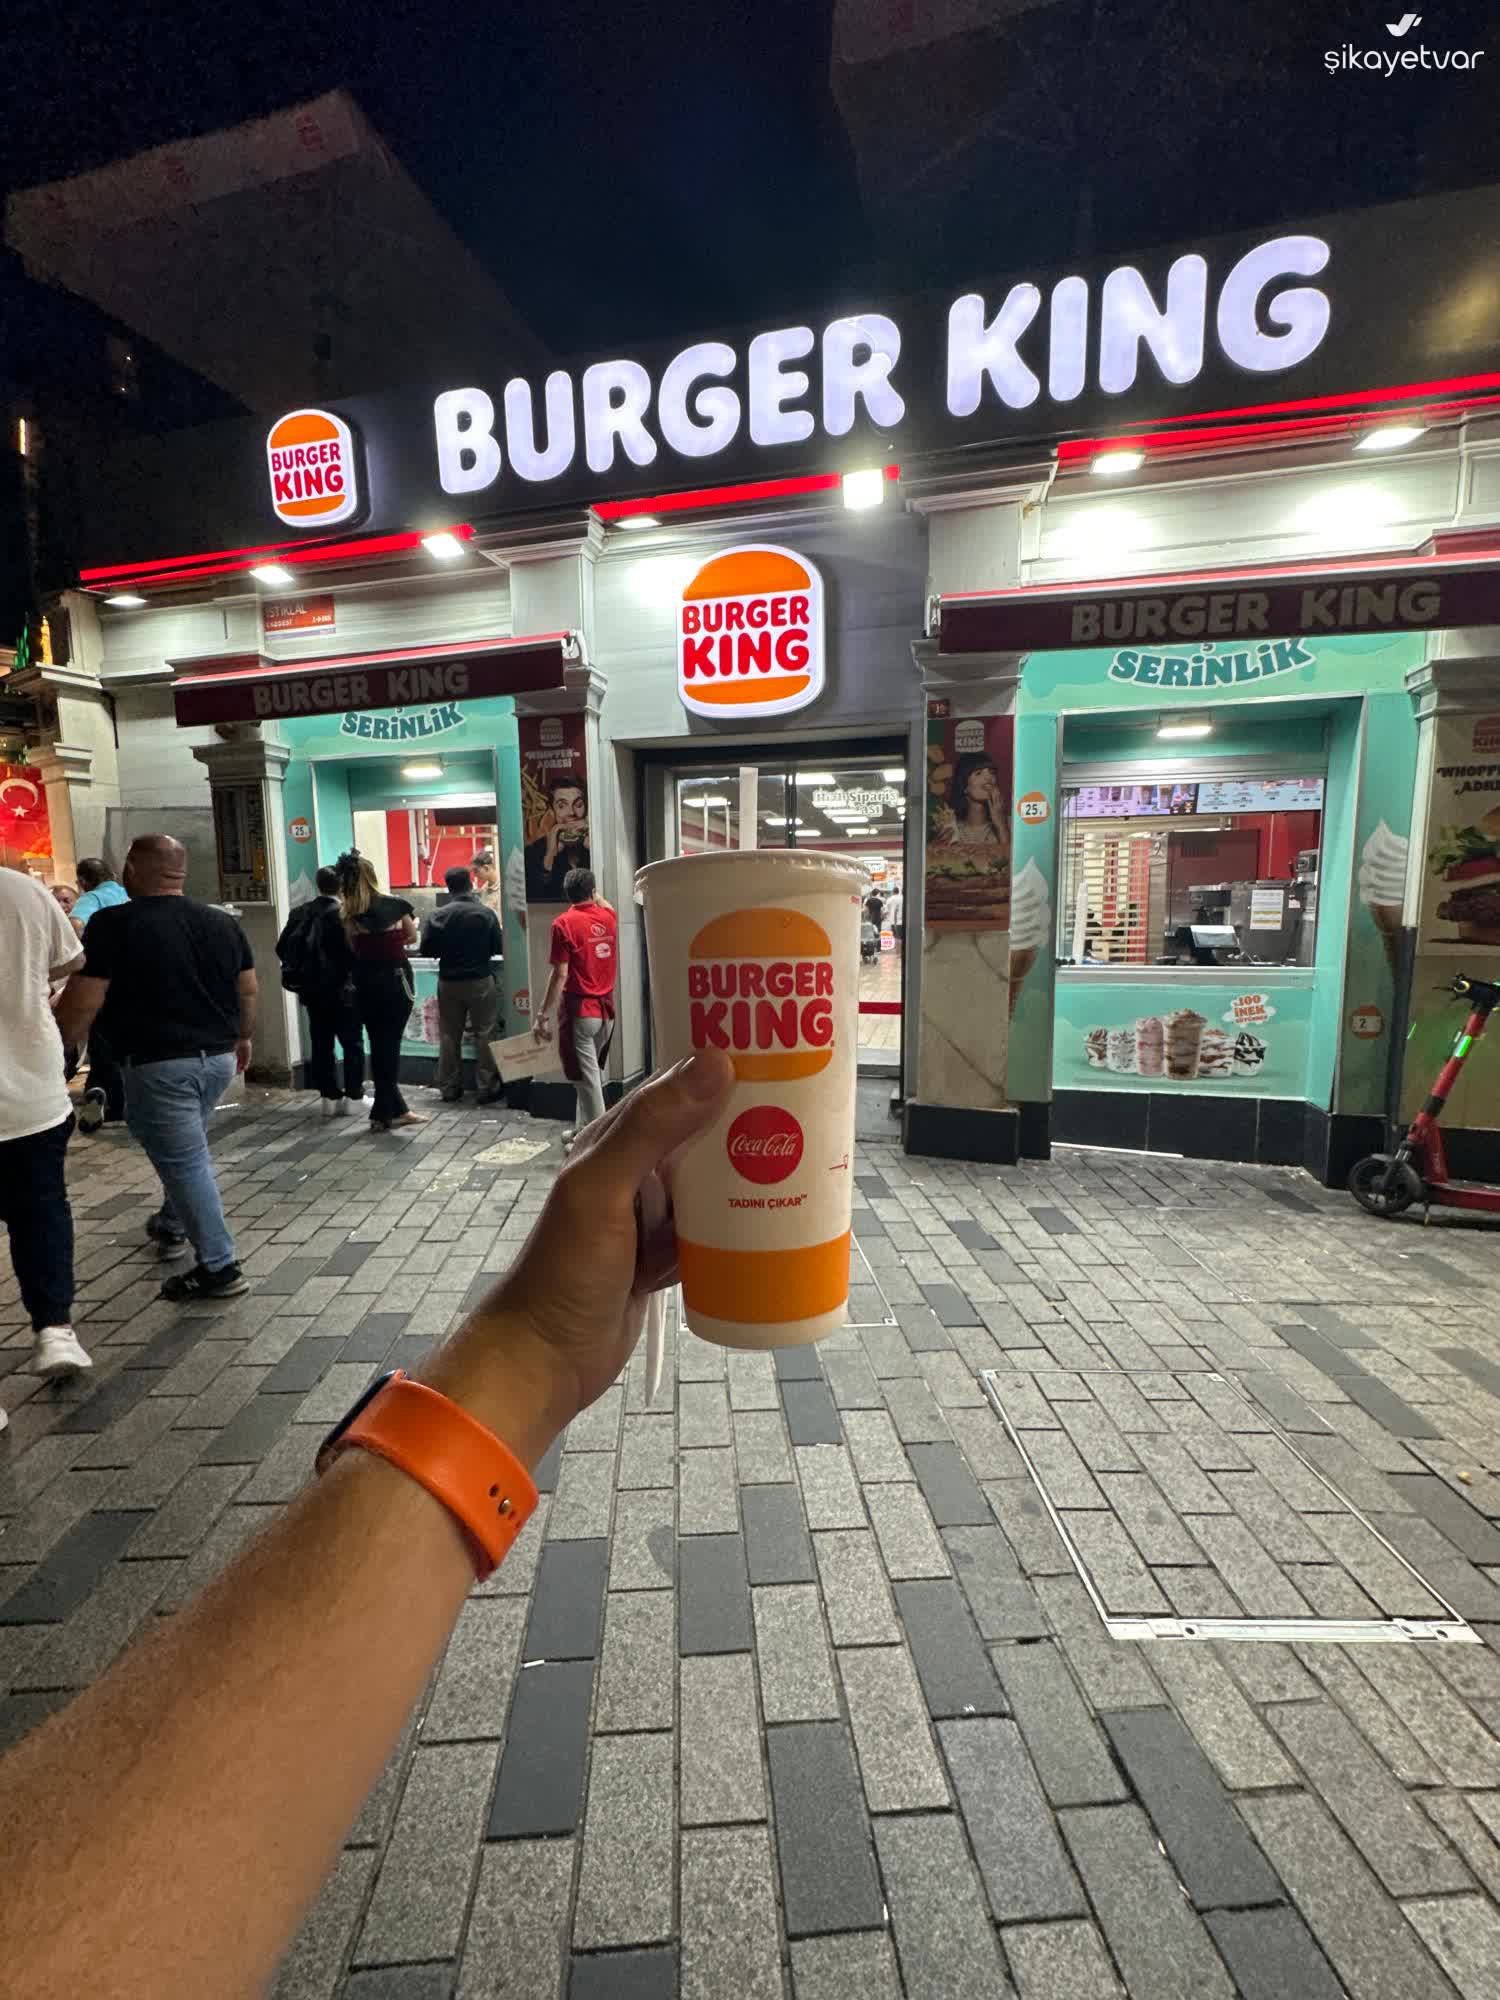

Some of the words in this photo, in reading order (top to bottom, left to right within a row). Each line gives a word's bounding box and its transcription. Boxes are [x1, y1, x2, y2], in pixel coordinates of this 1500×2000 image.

[434, 314, 905, 494] BURGER
[947, 235, 1330, 416] KING
[271, 442, 341, 472] BURGER
[274, 463, 344, 502] KING
[682, 595, 810, 635] BURGER
[1071, 592, 1270, 642] BURGER
[1301, 581, 1441, 628] KING
[683, 628, 810, 679] KING
[254, 674, 372, 715] BURGER
[387, 663, 469, 700] KING
[687, 962, 834, 999] BURGER
[690, 998, 833, 1049] KING
